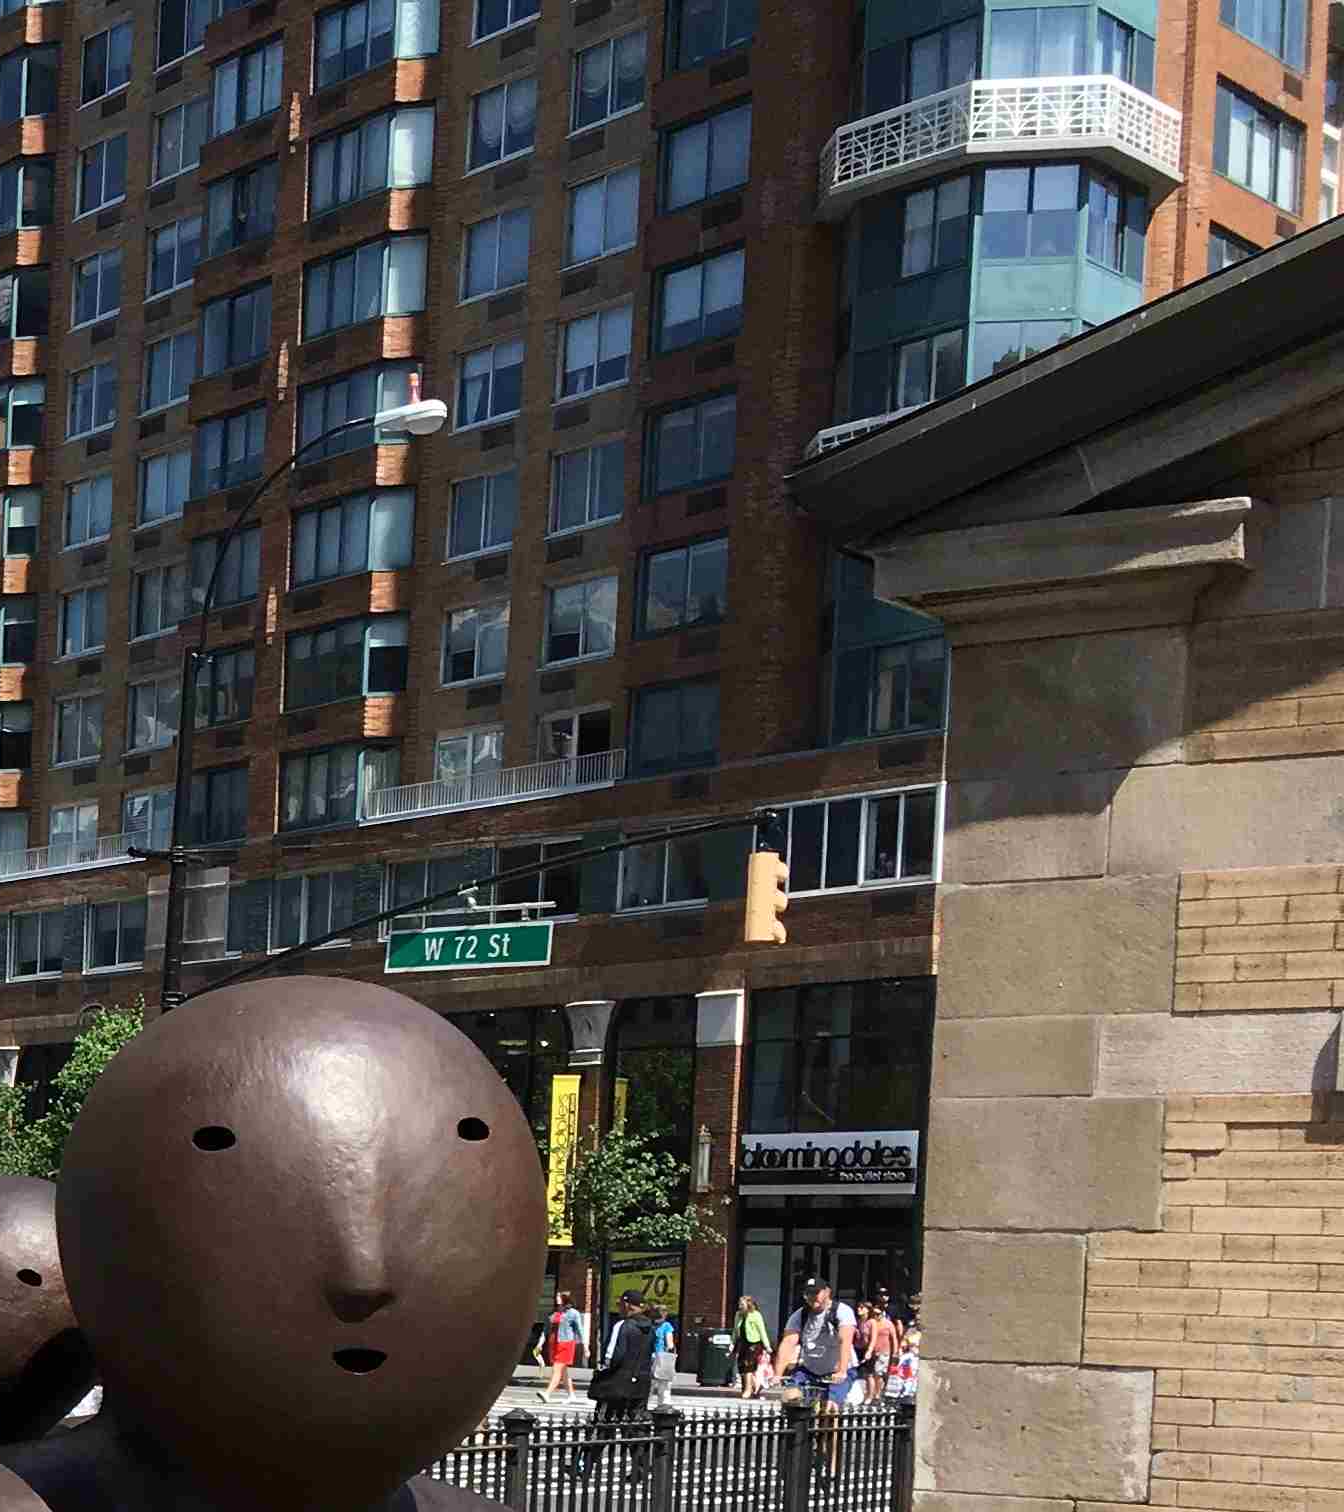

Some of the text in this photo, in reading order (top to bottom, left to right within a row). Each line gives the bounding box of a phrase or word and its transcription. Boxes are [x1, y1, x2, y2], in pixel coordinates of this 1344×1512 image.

[424, 932, 511, 961] W 72 St
[839, 1171, 854, 1182] the
[854, 1171, 881, 1182] outlet
